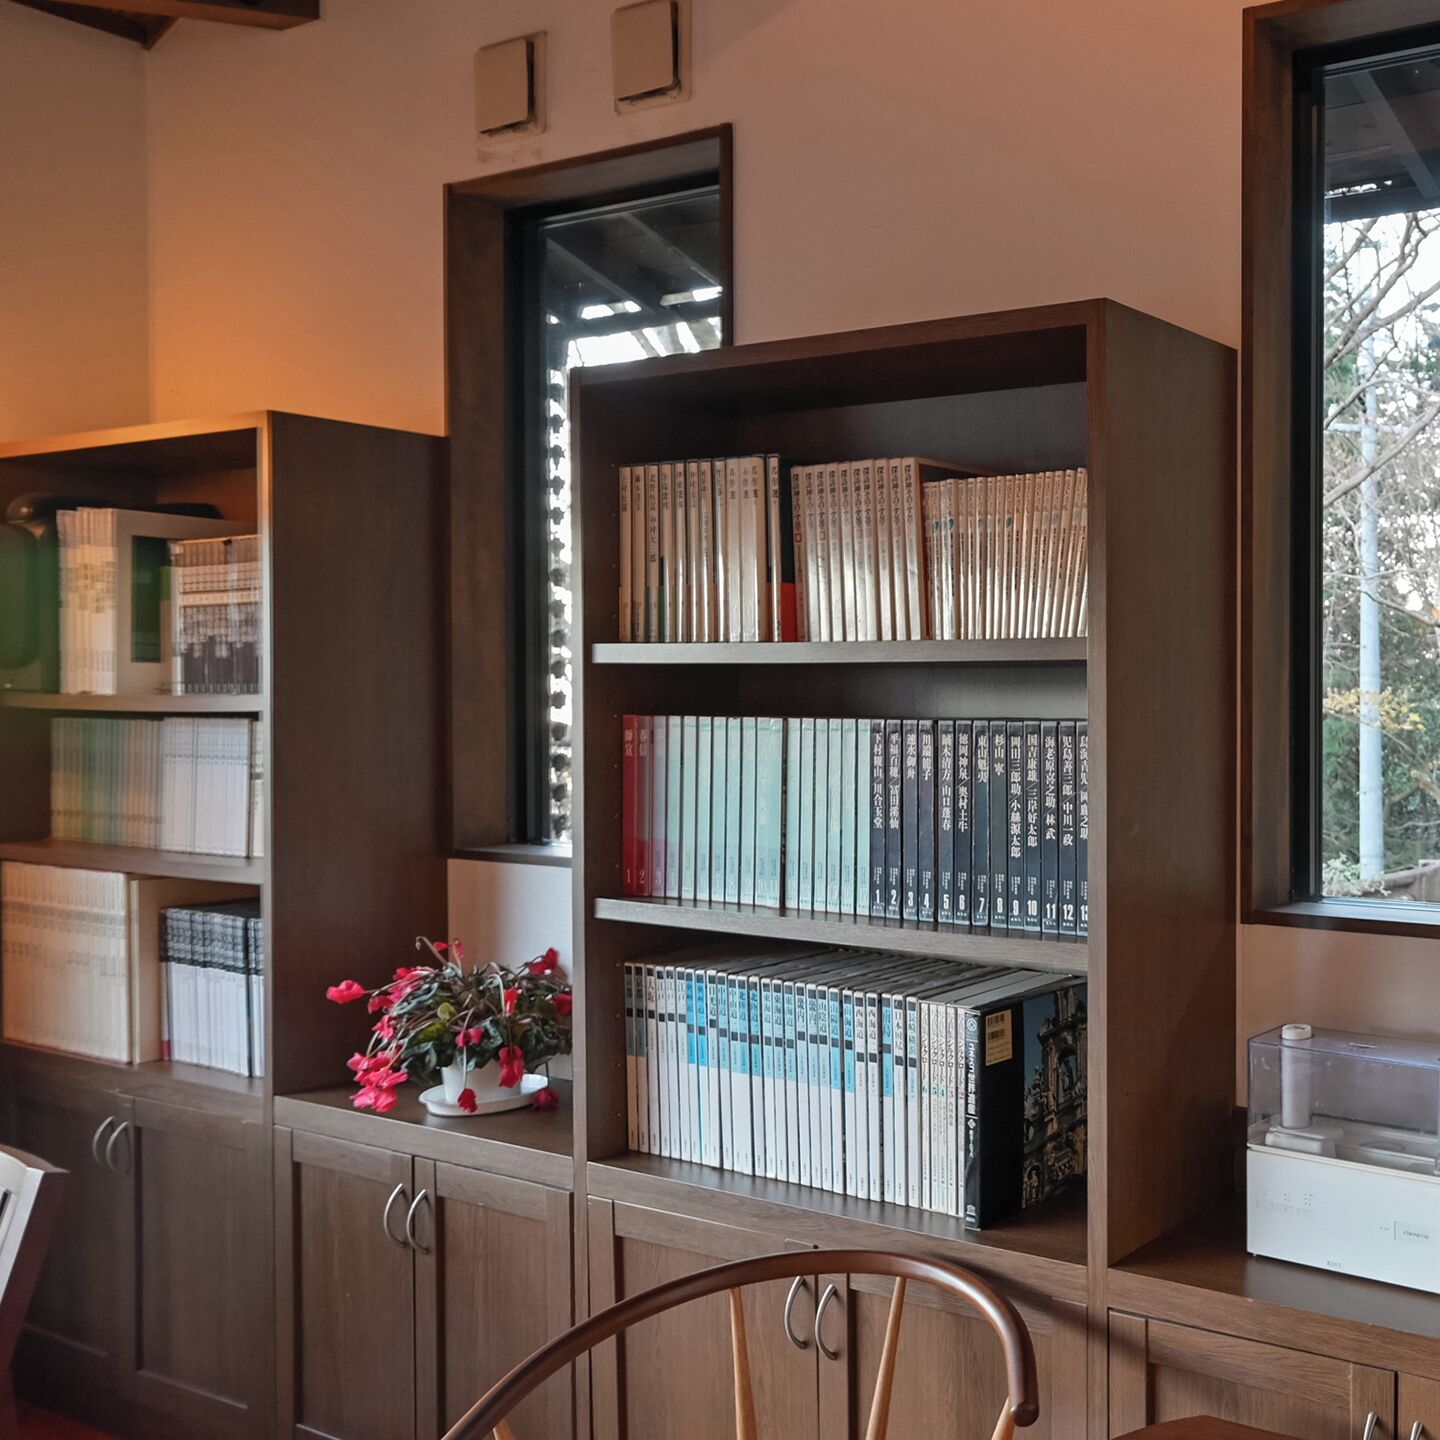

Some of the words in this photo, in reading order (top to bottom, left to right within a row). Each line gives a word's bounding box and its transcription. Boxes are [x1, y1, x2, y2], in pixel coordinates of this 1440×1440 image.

[627, 870, 630, 882] 1
[640, 872, 644, 883] 2
[876, 890, 879, 903] 1
[891, 890, 896, 904] 2
[908, 892, 913, 906] 3
[924, 893, 929, 908] 4
[944, 894, 949, 909] 5
[959, 895, 964, 910] 6
[979, 897, 985, 912] 7
[997, 898, 1002, 913] 8
[1013, 900, 1018, 915] 9
[1028, 900, 1037, 915] 10
[1046, 904, 1056, 918] 11
[1064, 904, 1073, 920] 12
